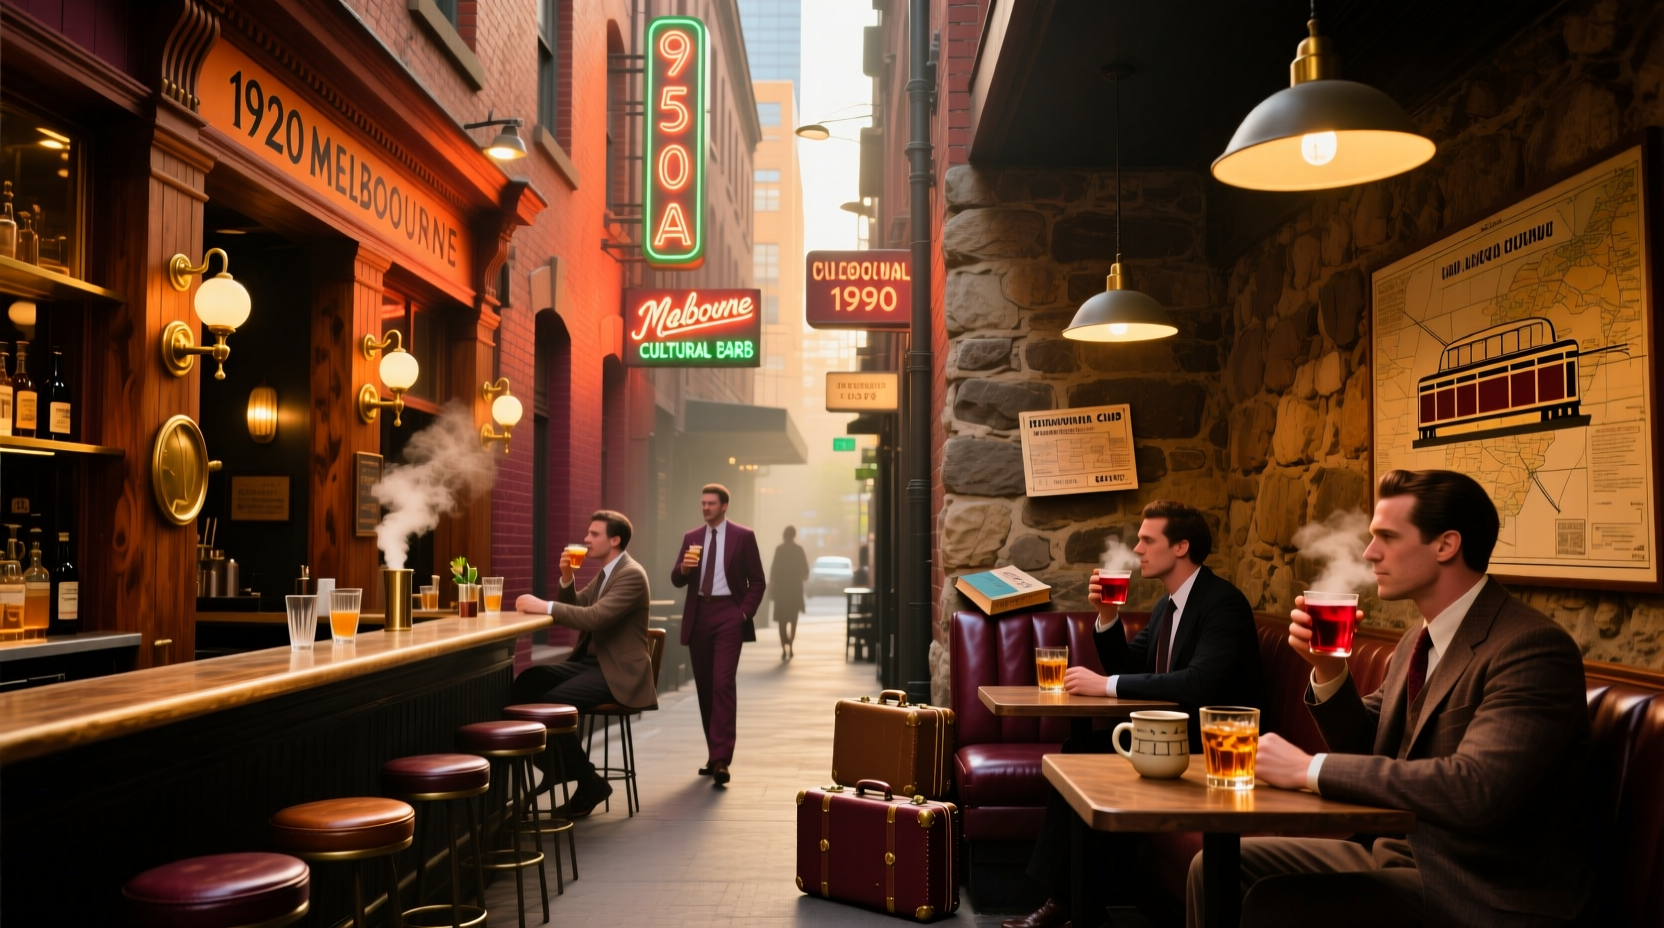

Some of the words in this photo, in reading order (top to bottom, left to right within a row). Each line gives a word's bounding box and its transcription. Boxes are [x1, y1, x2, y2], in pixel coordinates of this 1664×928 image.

[229, 70, 304, 165] 1920
[310, 125, 457, 268] MELBOOURNE
[653, 30, 692, 246] 950A
[639, 341, 712, 359] CULTURAL
[830, 286, 897, 312] 1990
